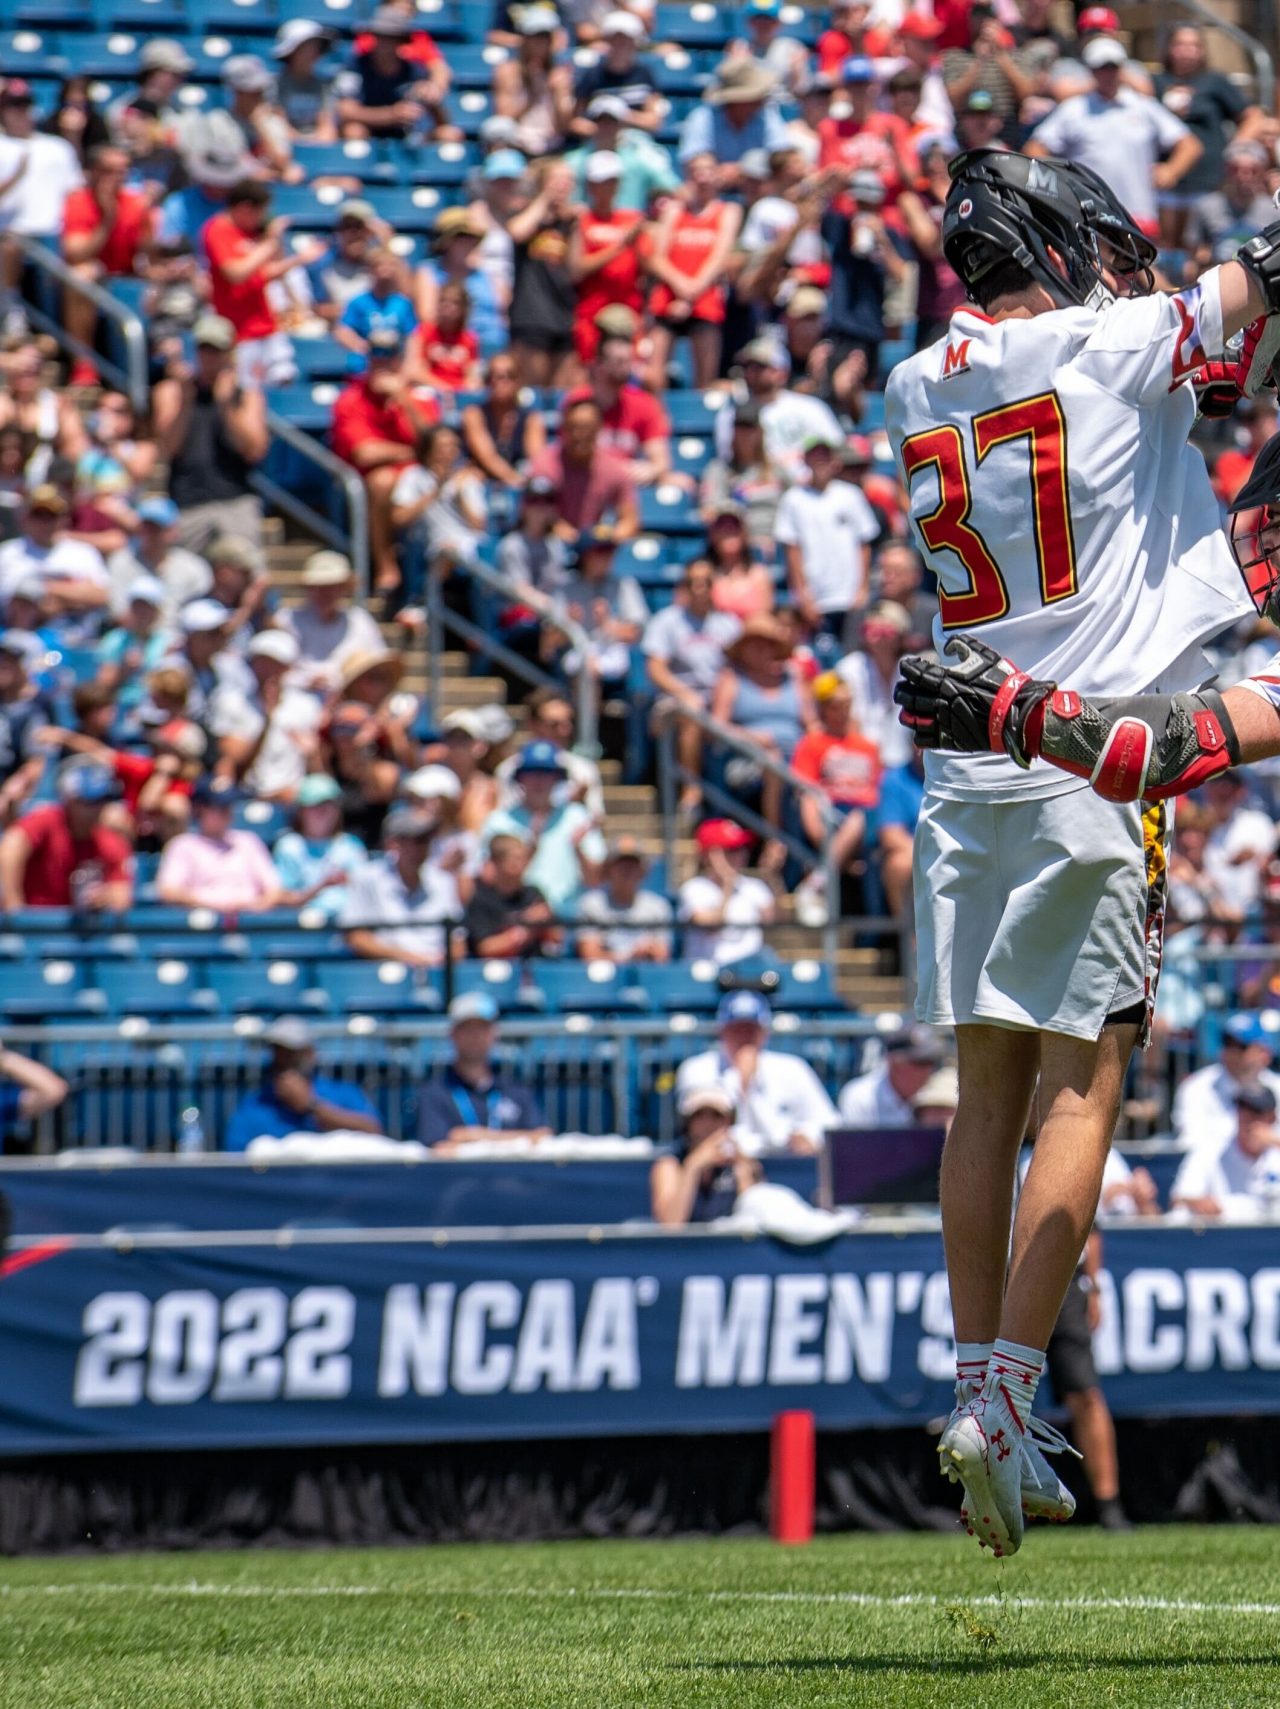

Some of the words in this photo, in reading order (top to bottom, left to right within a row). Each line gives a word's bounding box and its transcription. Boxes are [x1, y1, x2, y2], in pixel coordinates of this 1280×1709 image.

[1025, 159, 1059, 194] M
[942, 339, 972, 375] M
[901, 389, 1078, 631] 37
[74, 1286, 356, 1407] 2022
